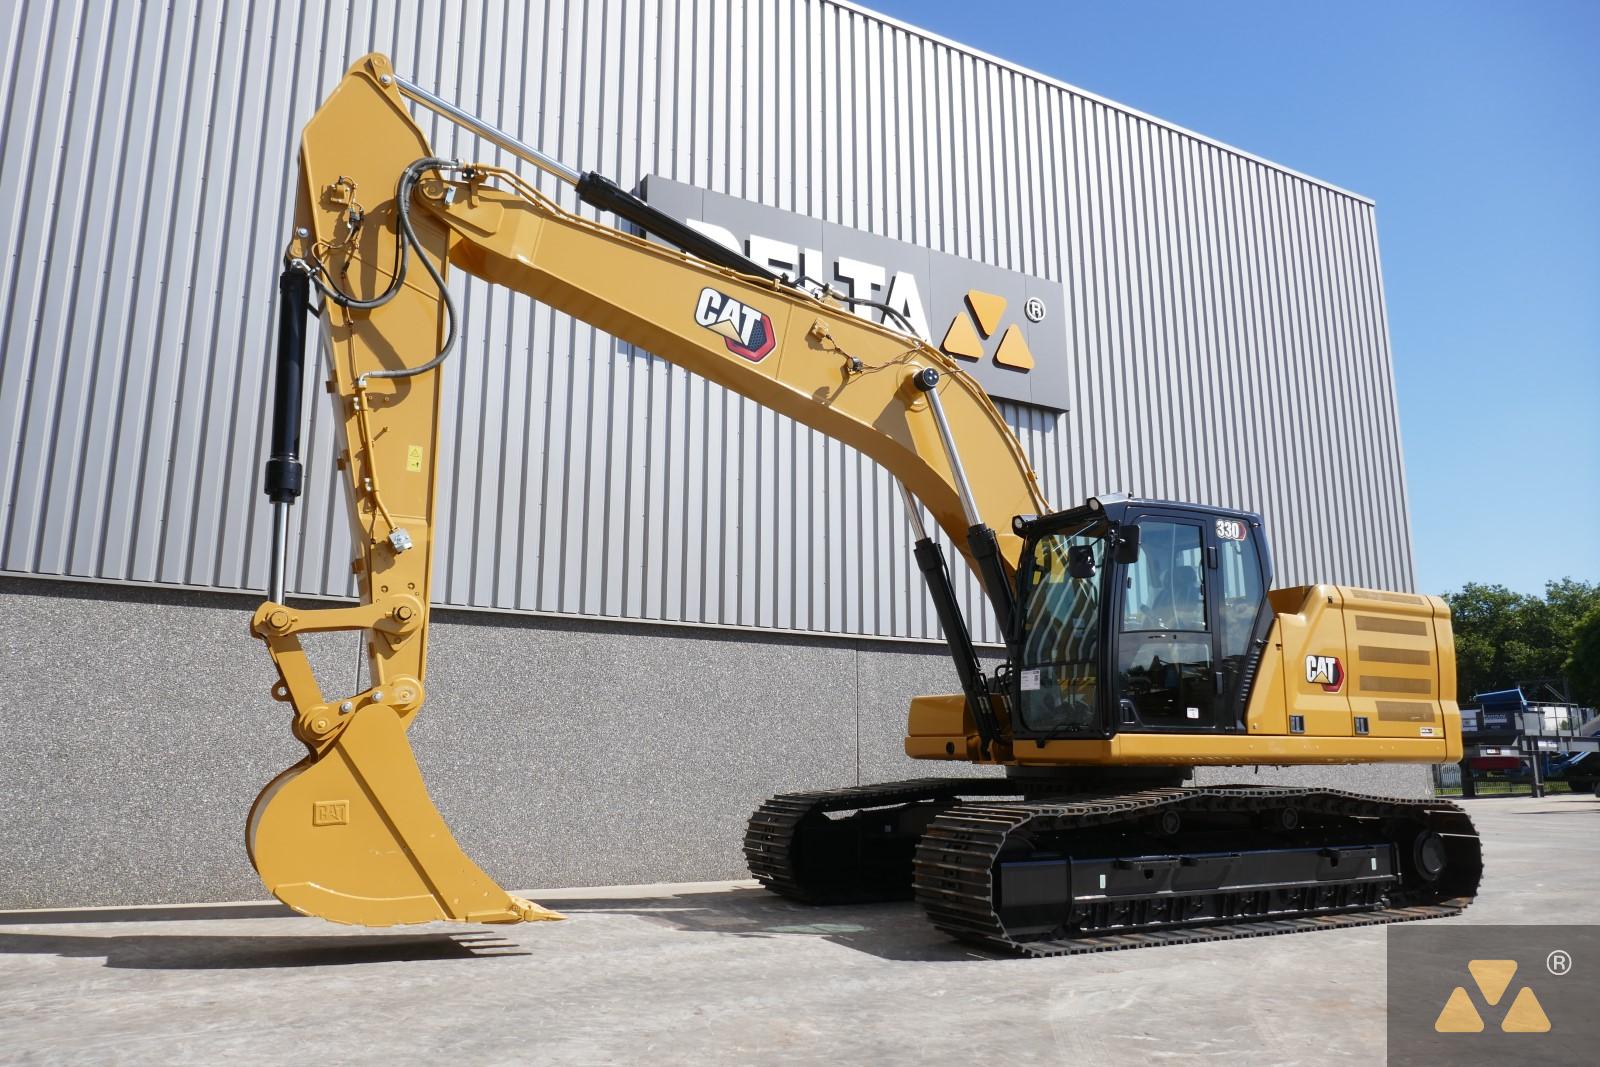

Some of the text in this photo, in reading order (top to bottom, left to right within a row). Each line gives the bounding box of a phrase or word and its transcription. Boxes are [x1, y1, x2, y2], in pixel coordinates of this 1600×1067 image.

[694, 287, 762, 346] CAT
[1216, 519, 1240, 539] 330
[1305, 655, 1336, 684] CAT
